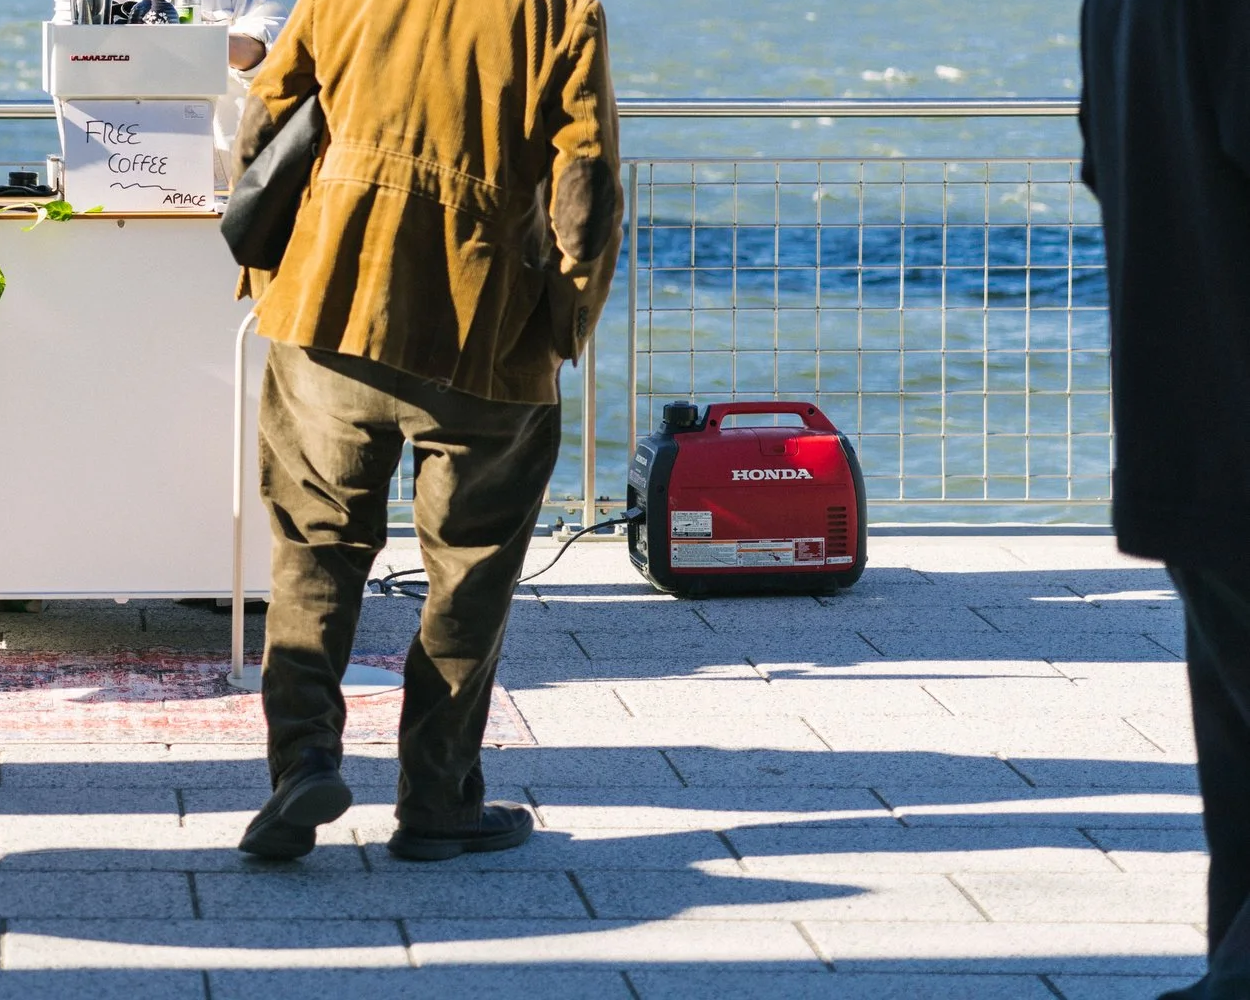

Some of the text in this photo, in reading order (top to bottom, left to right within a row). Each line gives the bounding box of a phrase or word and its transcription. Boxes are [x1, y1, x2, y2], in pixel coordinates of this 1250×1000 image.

[86, 120, 141, 145] FREE
[108, 153, 168, 175] COFFEE
[162, 193, 206, 207] APIACE
[731, 468, 814, 481] HONDA
